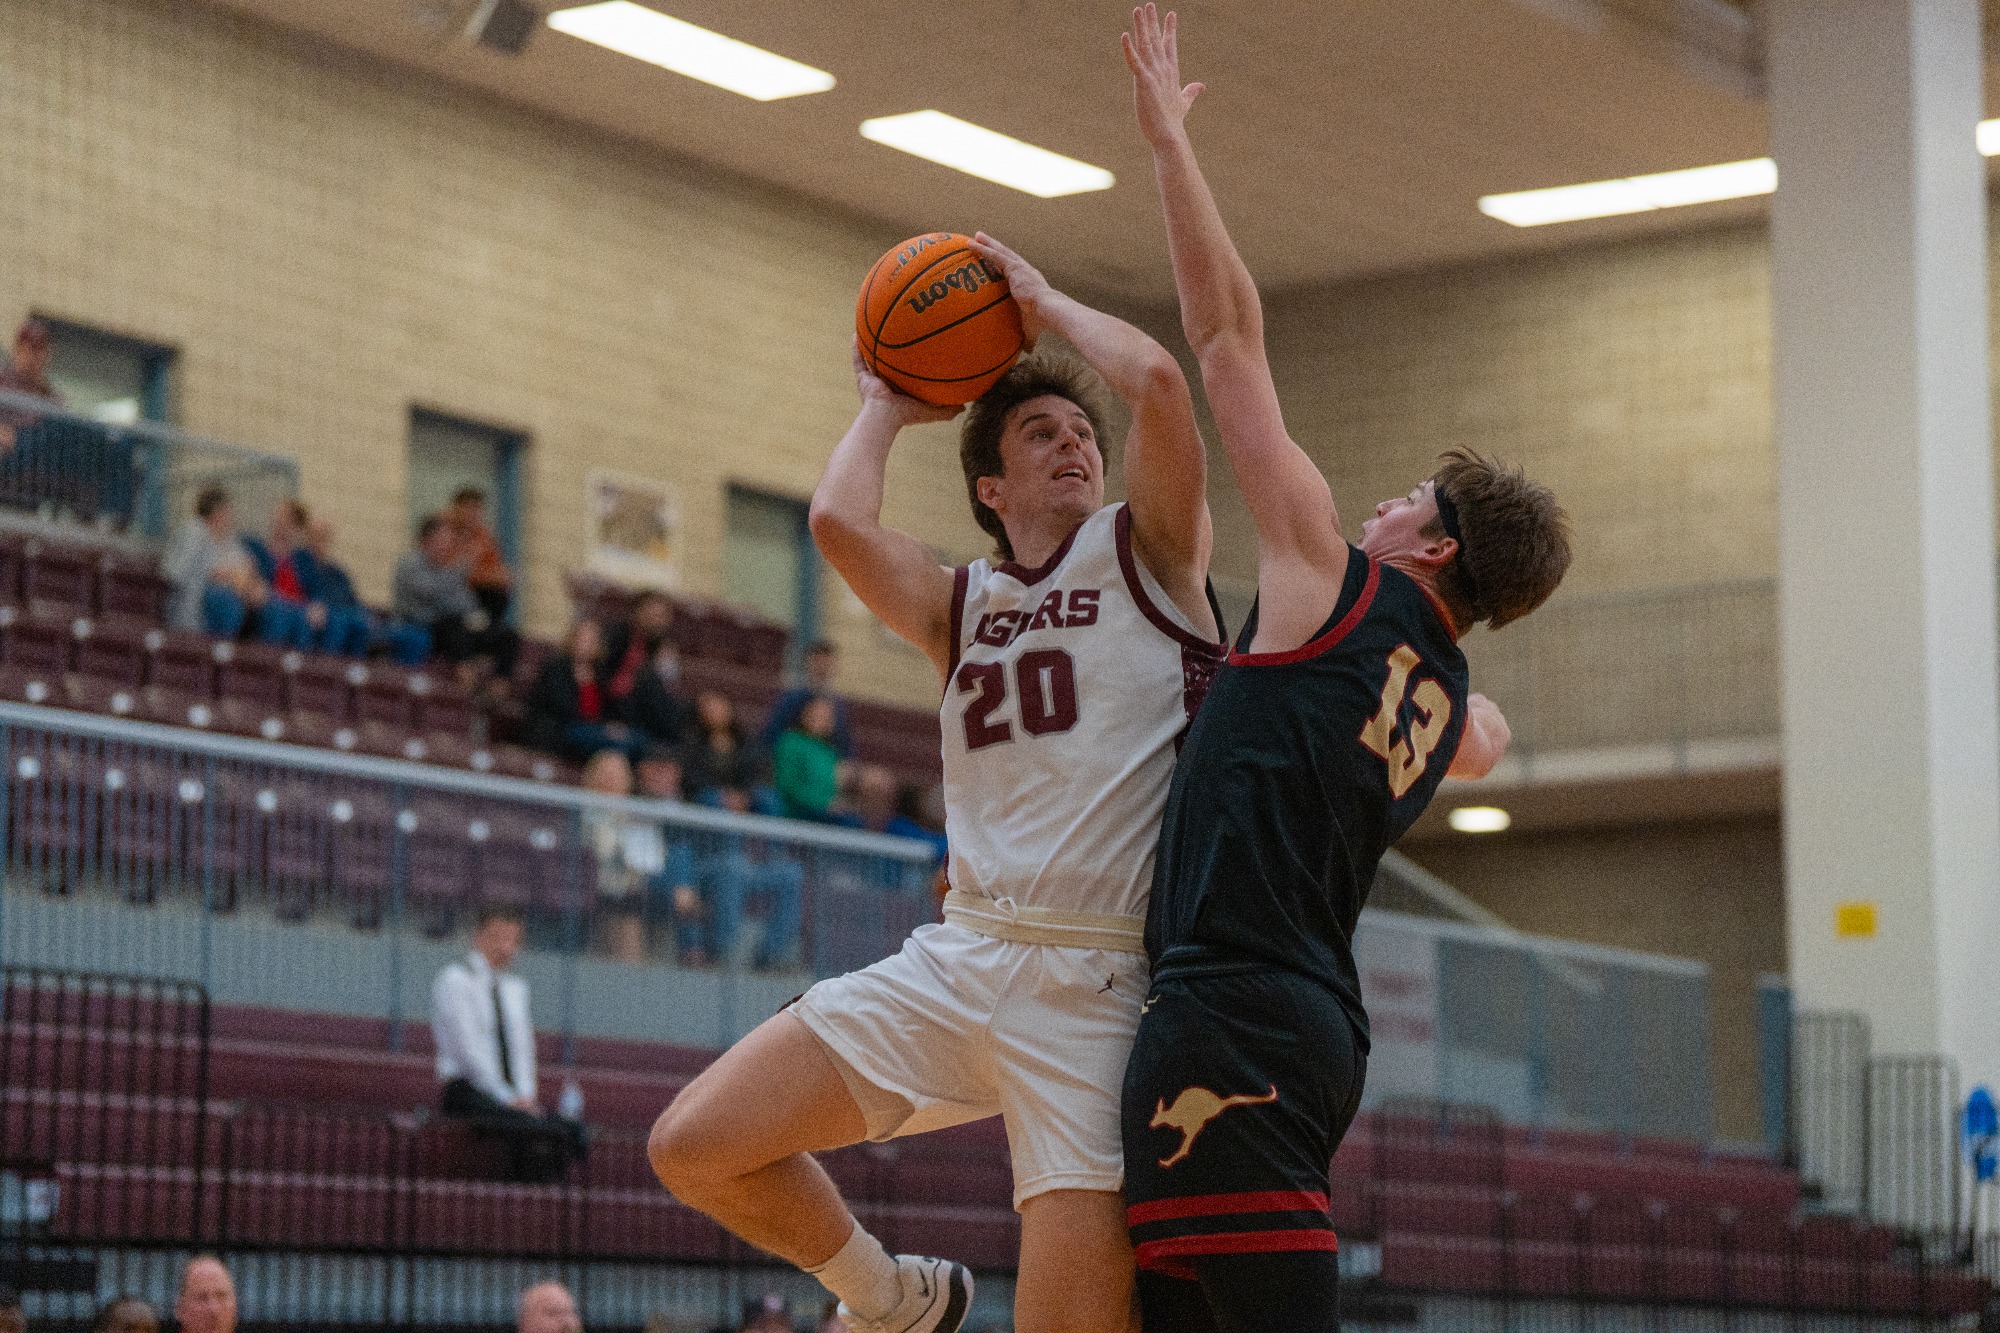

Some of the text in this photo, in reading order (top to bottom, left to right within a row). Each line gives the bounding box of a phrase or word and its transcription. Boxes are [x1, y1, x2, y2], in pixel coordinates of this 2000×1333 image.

[966, 589, 1101, 649] IGRS
[955, 646, 1082, 755] 20
[1357, 641, 1453, 801] 13
